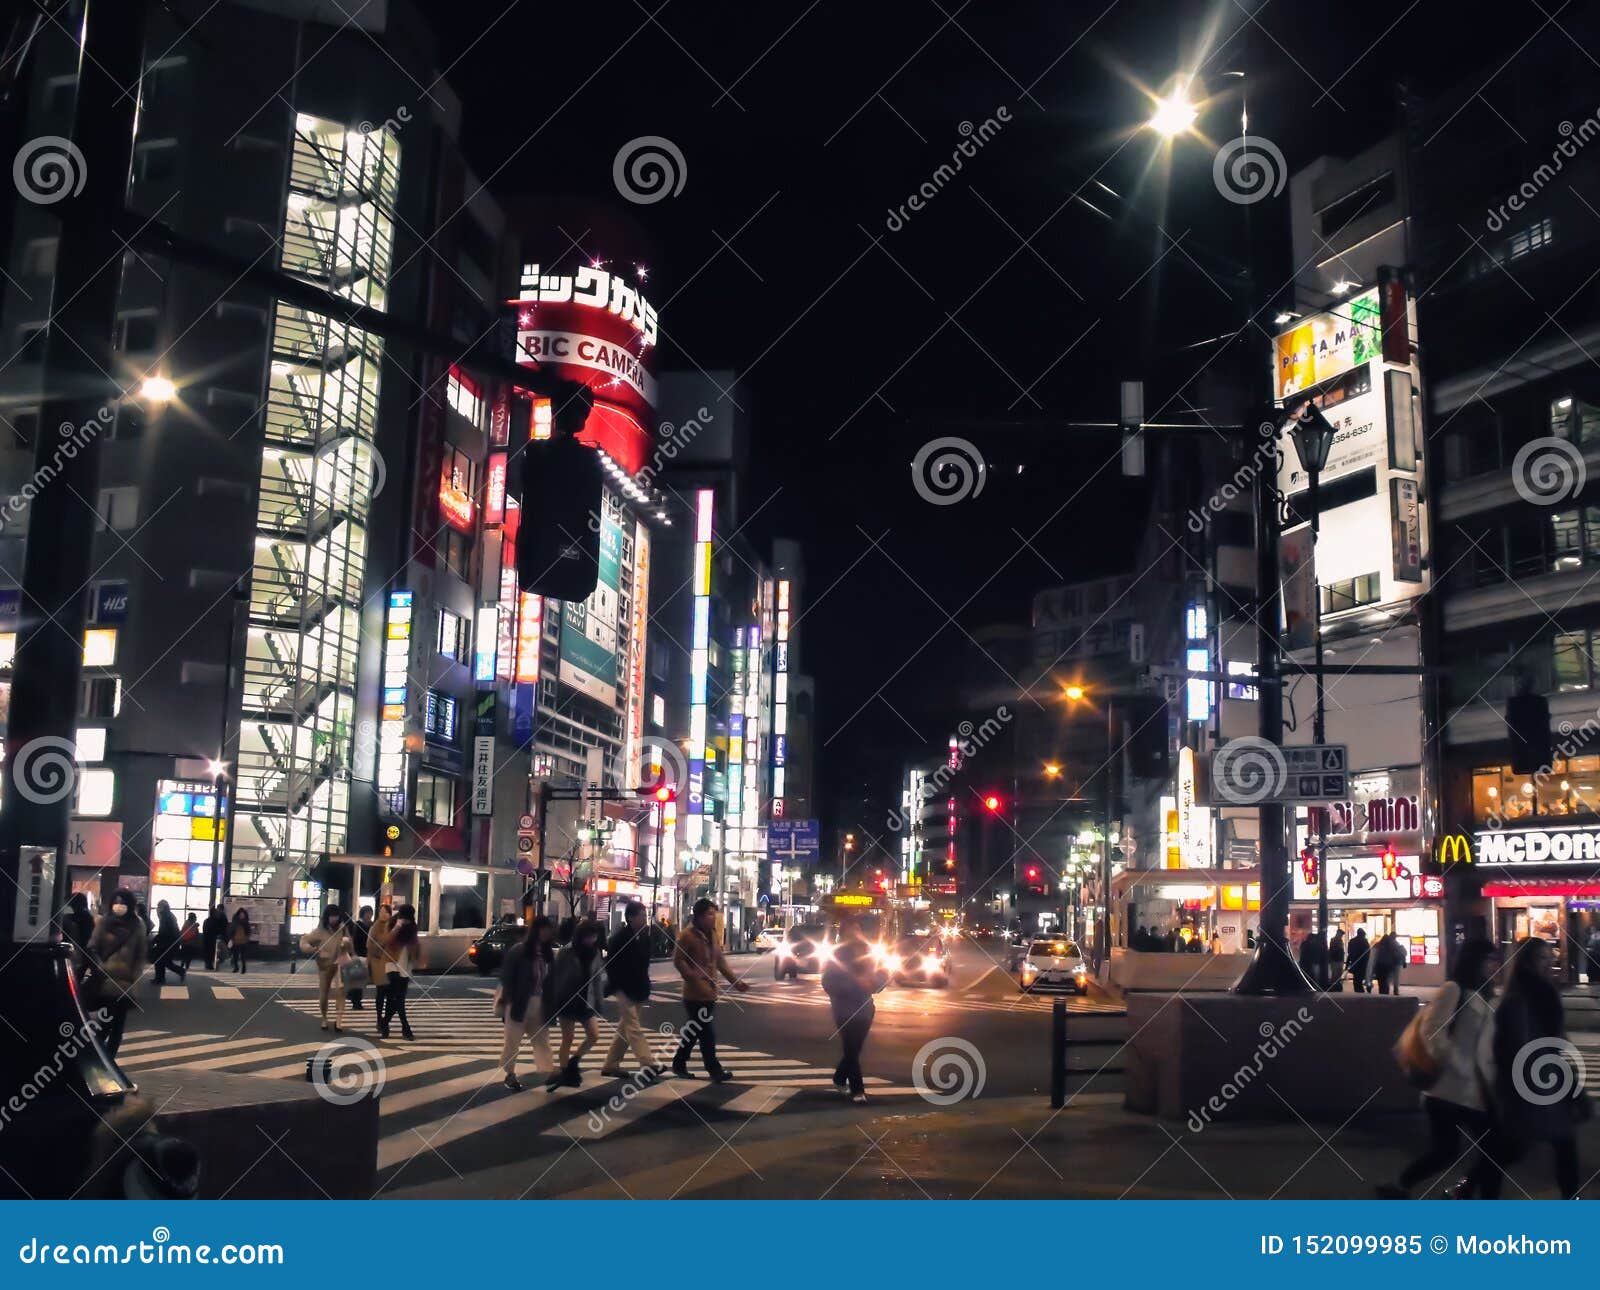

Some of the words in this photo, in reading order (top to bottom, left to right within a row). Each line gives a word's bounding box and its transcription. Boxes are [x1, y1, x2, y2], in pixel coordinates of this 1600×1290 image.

[524, 336, 569, 358] BIC
[577, 341, 644, 391] CAMERA
[1283, 339, 1328, 369] PATA
[104, 597, 127, 610] HIS
[567, 611, 584, 630] NAVI
[476, 740, 489, 810] 三井住友銀行
[689, 772, 703, 803] TBC
[1308, 802, 1353, 834] mni
[1368, 796, 1418, 832] mini
